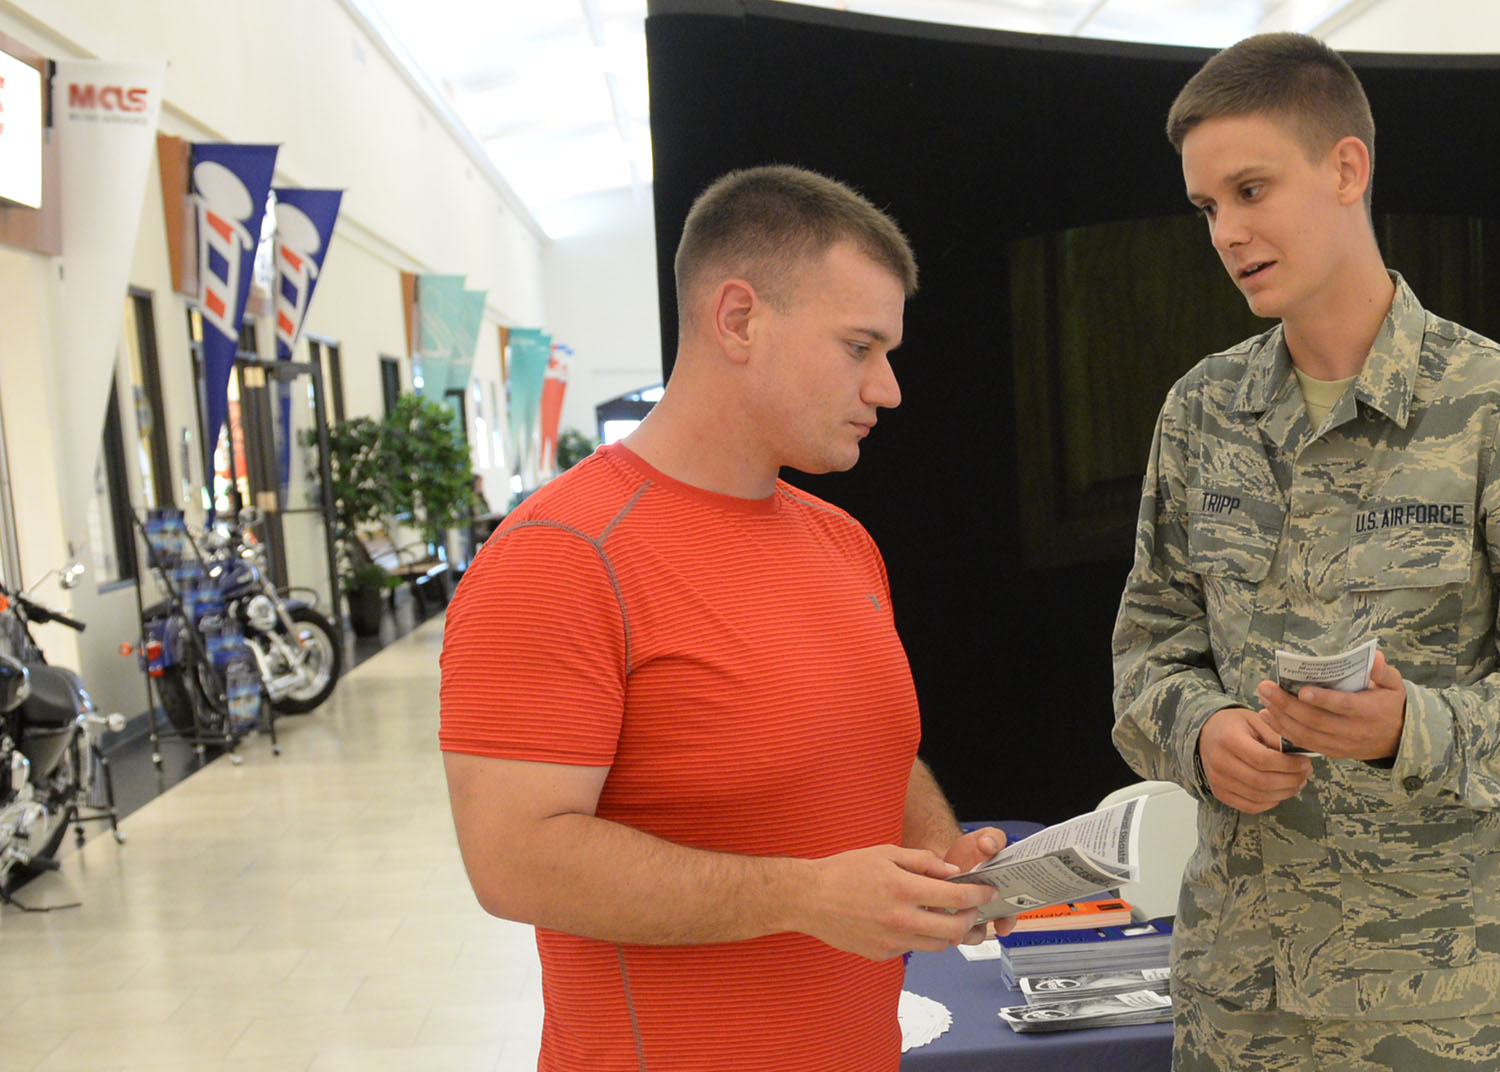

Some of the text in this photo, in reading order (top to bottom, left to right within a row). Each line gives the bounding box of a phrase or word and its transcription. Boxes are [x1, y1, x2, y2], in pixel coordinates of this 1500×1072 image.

[1202, 492, 1241, 516] TRIPP
[1355, 504, 1465, 533] U.S. AIR FORCE
